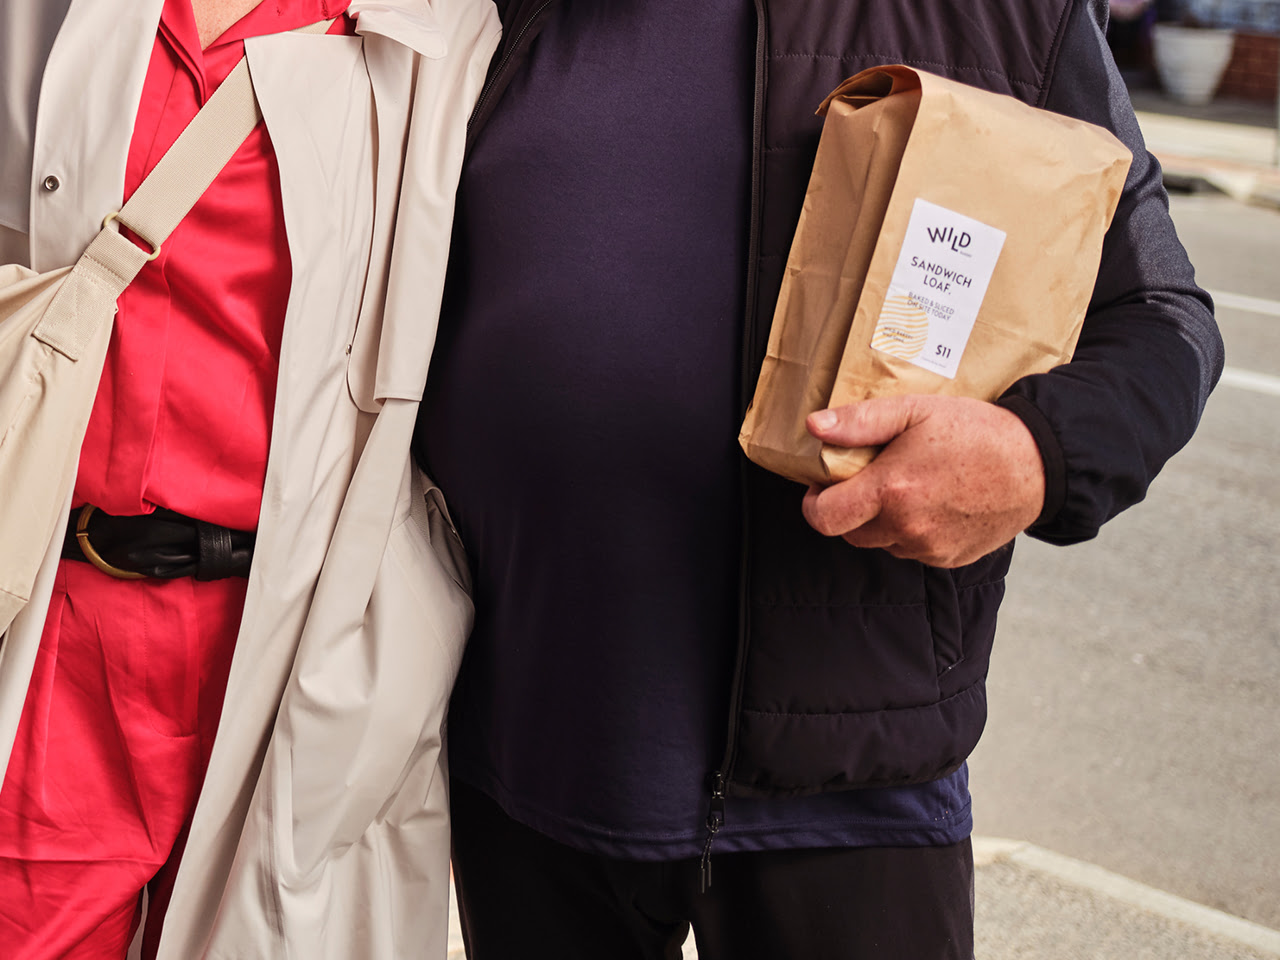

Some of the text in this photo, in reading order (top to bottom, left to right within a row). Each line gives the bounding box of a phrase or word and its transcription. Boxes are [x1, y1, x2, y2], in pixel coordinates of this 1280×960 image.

[927, 227, 971, 252] WILD
[910, 256, 972, 288] SANDWICH
[923, 274, 951, 295] LOAF.
[908, 291, 930, 305] BAKED
[934, 302, 955, 315] SLICED
[931, 308, 951, 321] TODAY
